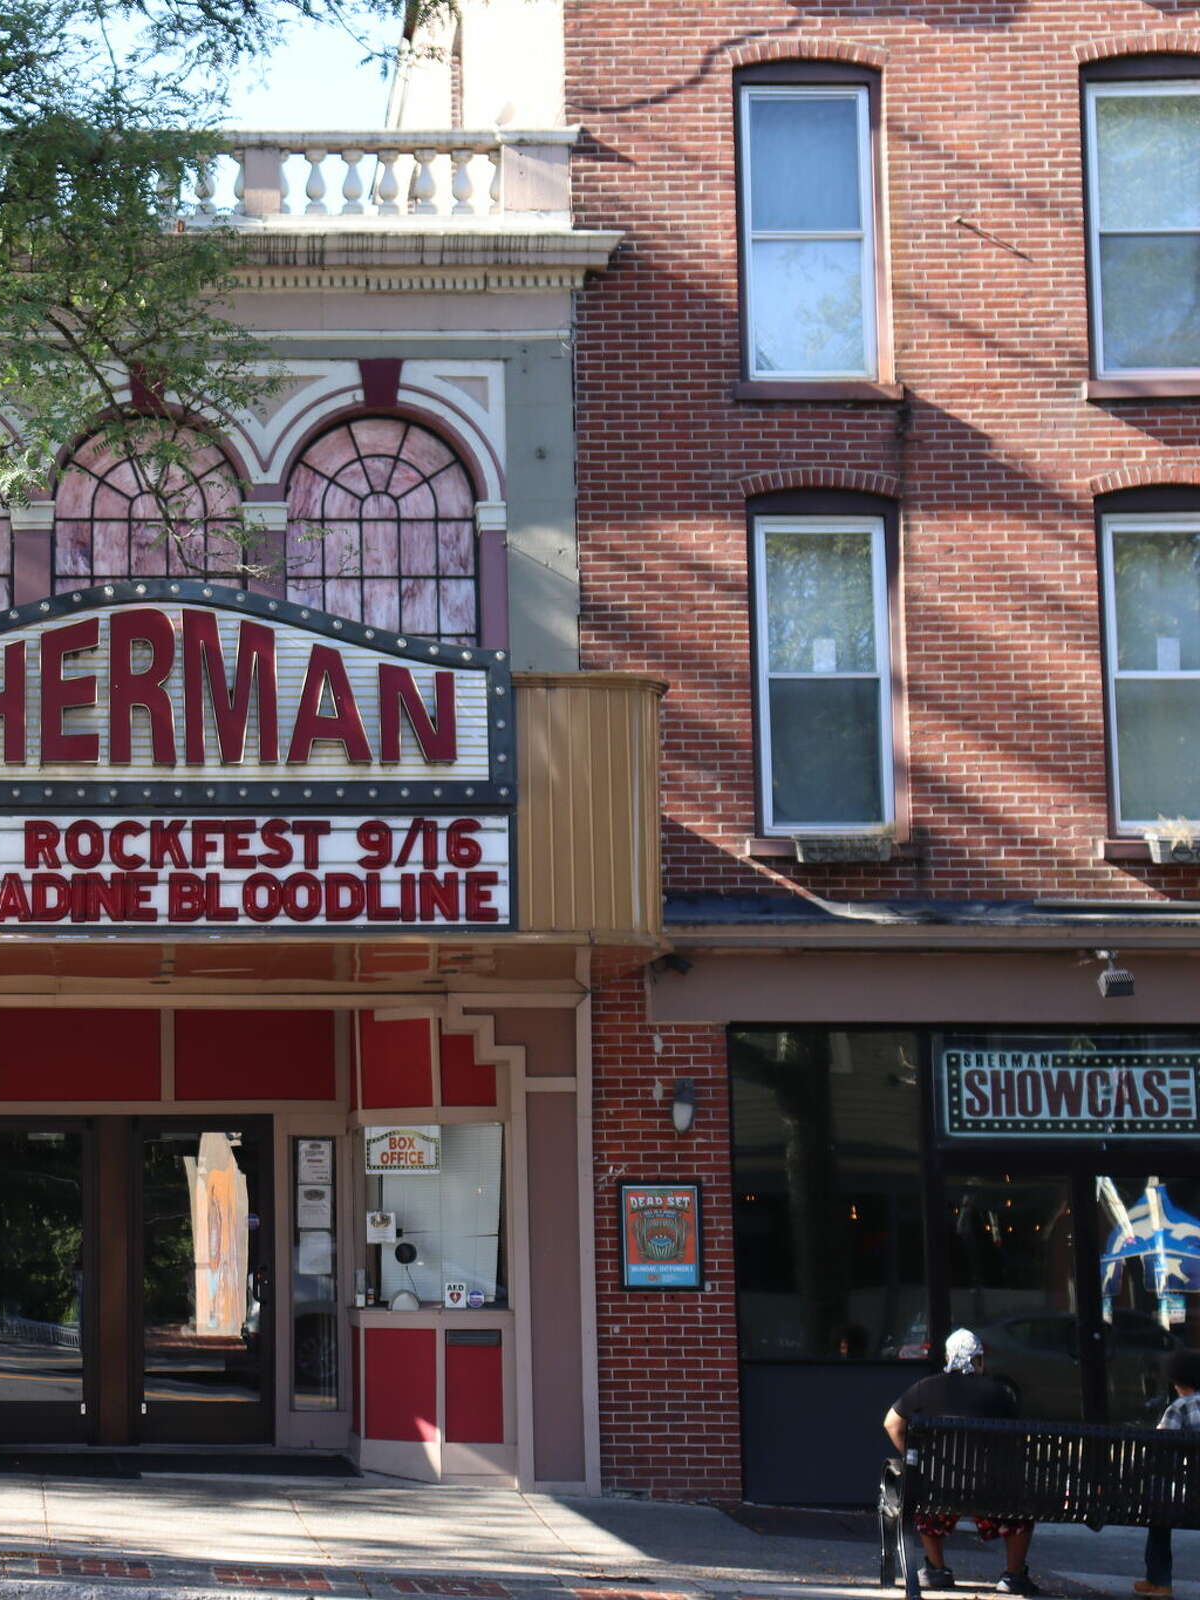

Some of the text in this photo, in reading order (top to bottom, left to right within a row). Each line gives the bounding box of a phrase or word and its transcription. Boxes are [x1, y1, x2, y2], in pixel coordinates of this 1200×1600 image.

[24, 819, 331, 870] ROCKFEST
[356, 818, 483, 869] 9/16
[167, 871, 498, 922] BLOODLINE
[963, 1053, 1049, 1068] SHERMAN
[964, 1069, 1193, 1118] SHOWCASE
[388, 1137, 416, 1149] BOX
[380, 1152, 424, 1164] OFFICE
[630, 1196, 690, 1210] DEAD SET
